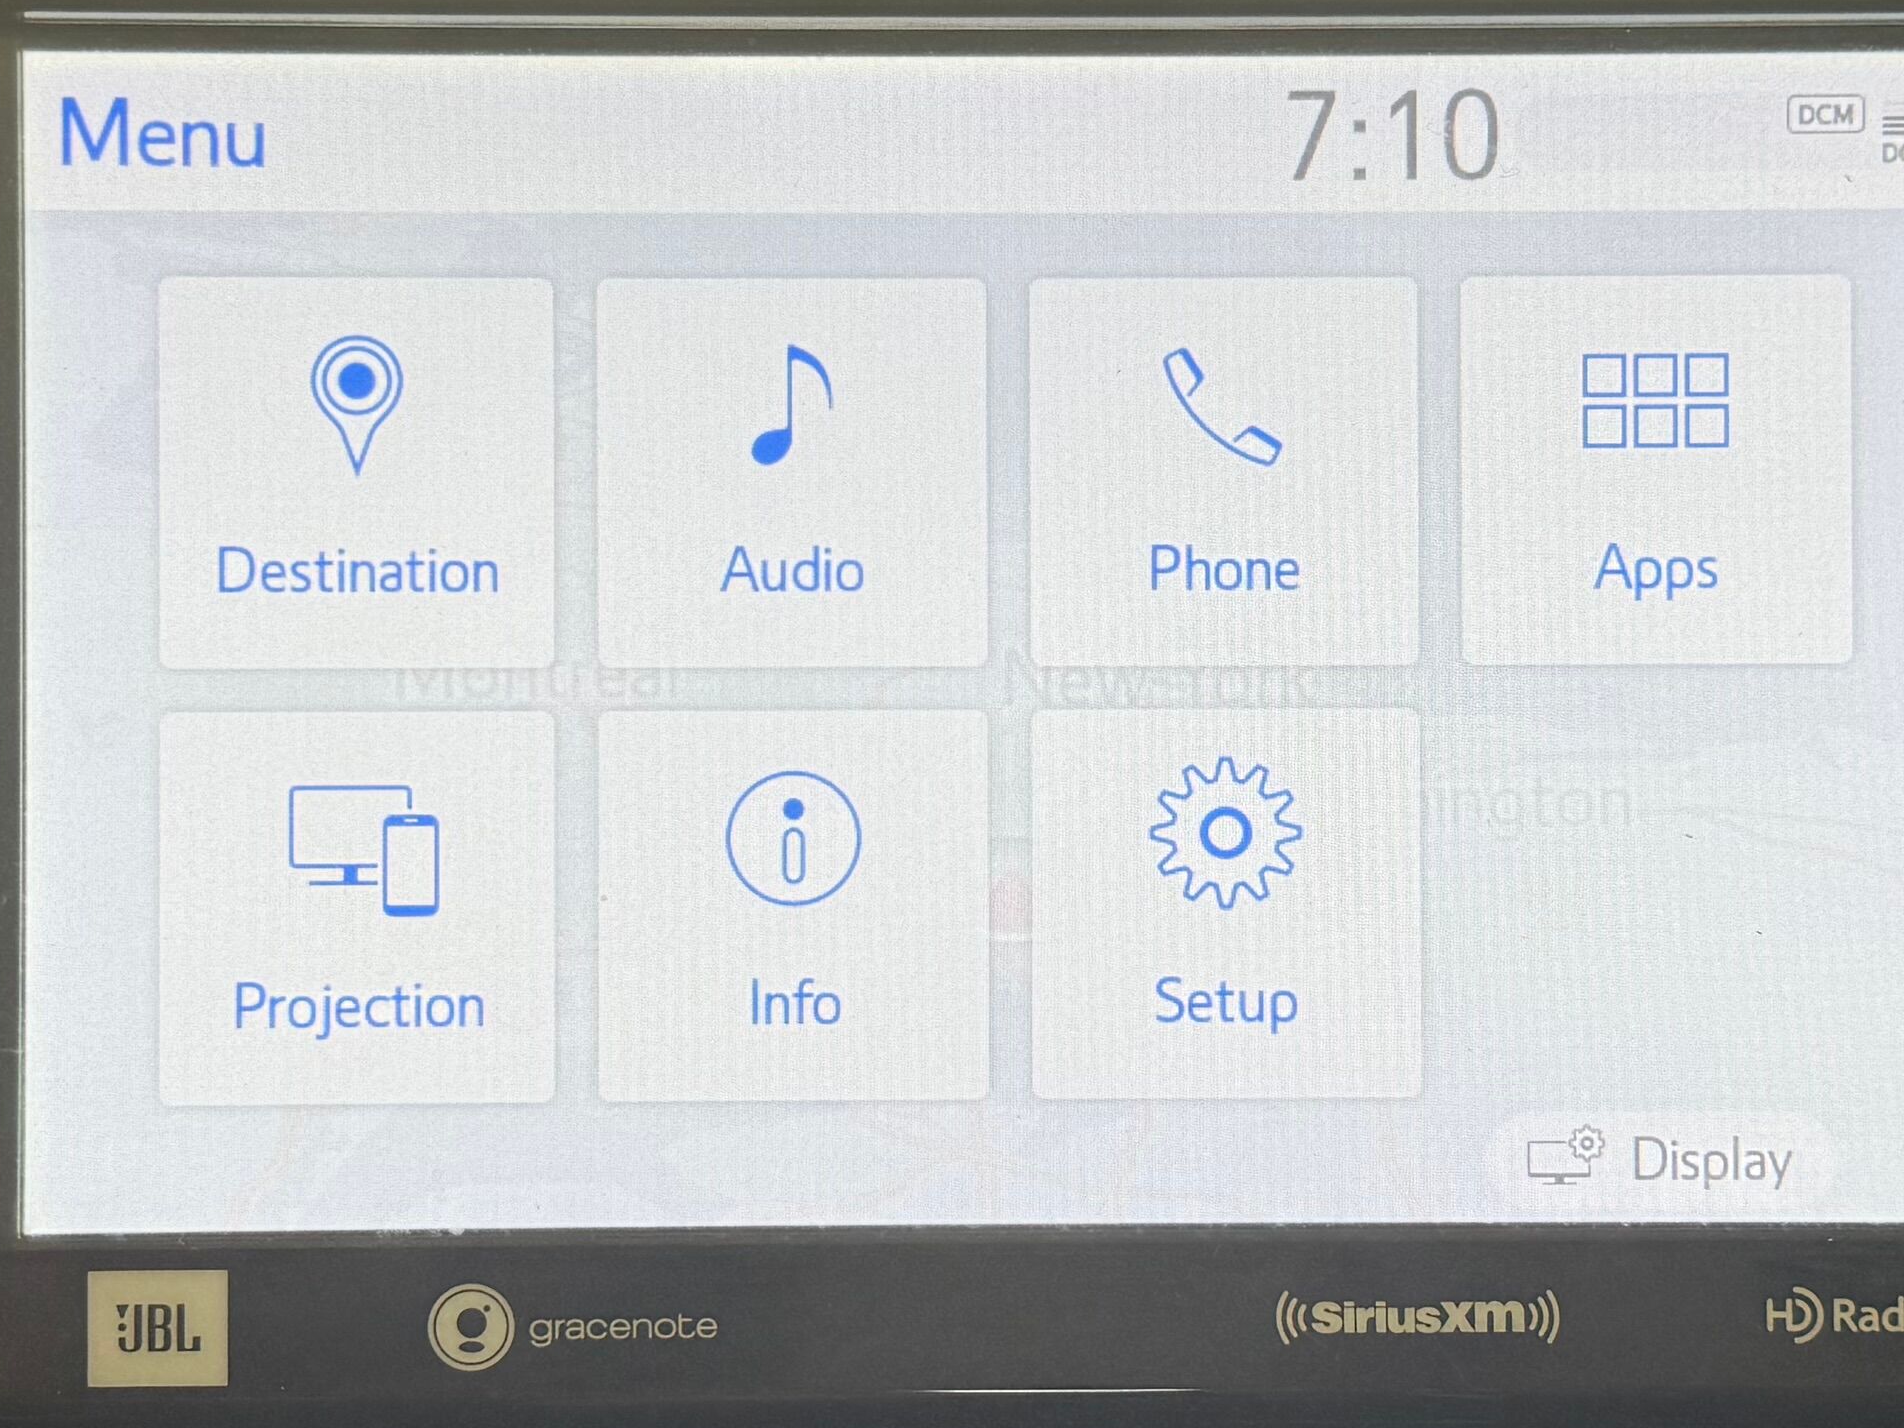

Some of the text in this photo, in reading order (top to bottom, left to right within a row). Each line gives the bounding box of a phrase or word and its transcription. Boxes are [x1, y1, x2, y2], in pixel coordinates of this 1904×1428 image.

[60, 97, 265, 168] Menu
[1287, 88, 1500, 182] 7:10
[1797, 104, 1855, 126] DCM
[216, 545, 499, 593] Destination
[720, 545, 865, 593] Audio
[1149, 543, 1301, 591] Phone
[1593, 542, 1719, 600] Apps
[233, 982, 485, 1039] Projection
[749, 978, 843, 1027] Info
[1154, 977, 1299, 1034] Setup
[1632, 1136, 1793, 1189] Display
[116, 1302, 201, 1354] JBL
[528, 1311, 718, 1346] gracenote
